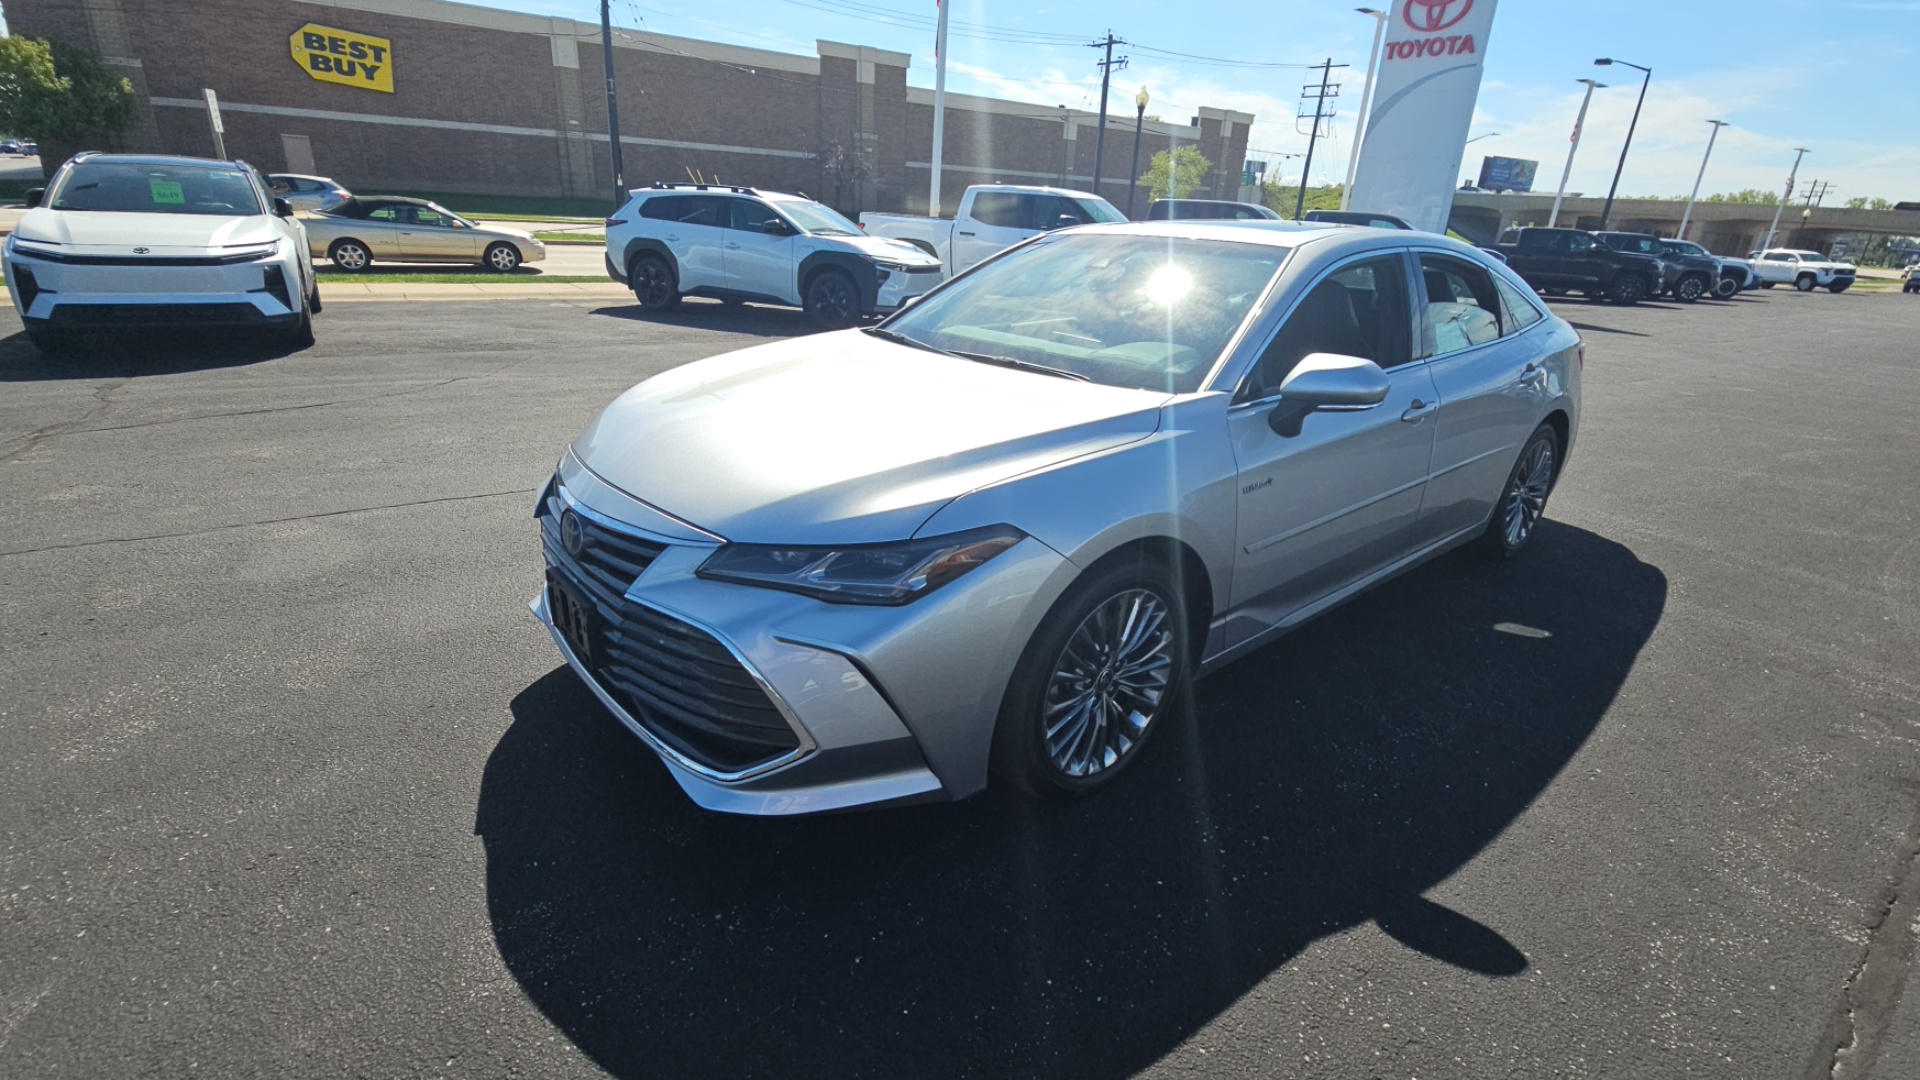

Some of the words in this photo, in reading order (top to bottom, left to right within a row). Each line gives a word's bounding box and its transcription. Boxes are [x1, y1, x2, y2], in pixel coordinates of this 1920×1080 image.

[303, 31, 387, 63] BEST
[1386, 34, 1475, 60] TOYOTA
[309, 52, 381, 81] BUY
